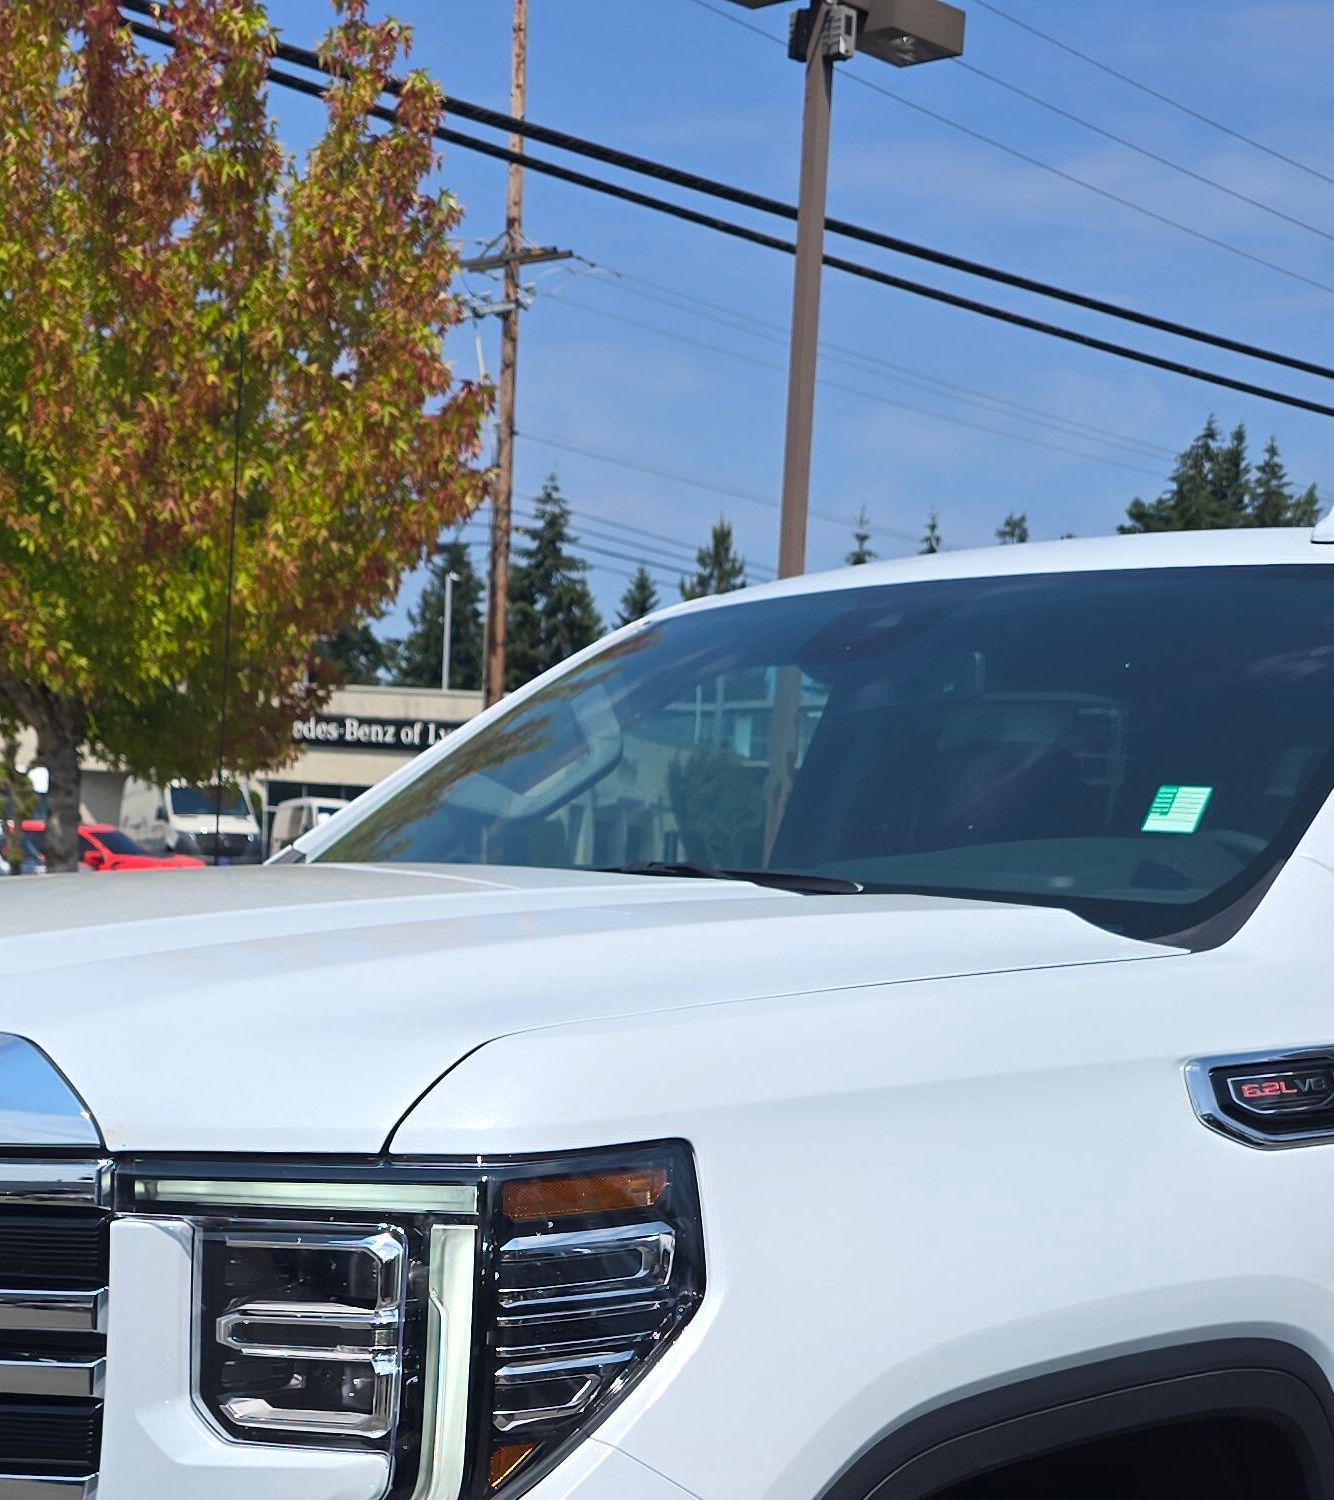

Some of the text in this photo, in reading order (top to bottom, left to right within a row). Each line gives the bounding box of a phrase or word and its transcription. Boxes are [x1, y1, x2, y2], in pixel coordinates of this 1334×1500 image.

[291, 716, 396, 744] edes-Benz
[400, 720, 424, 745] of
[1241, 1081, 1297, 1098] 6.2L
